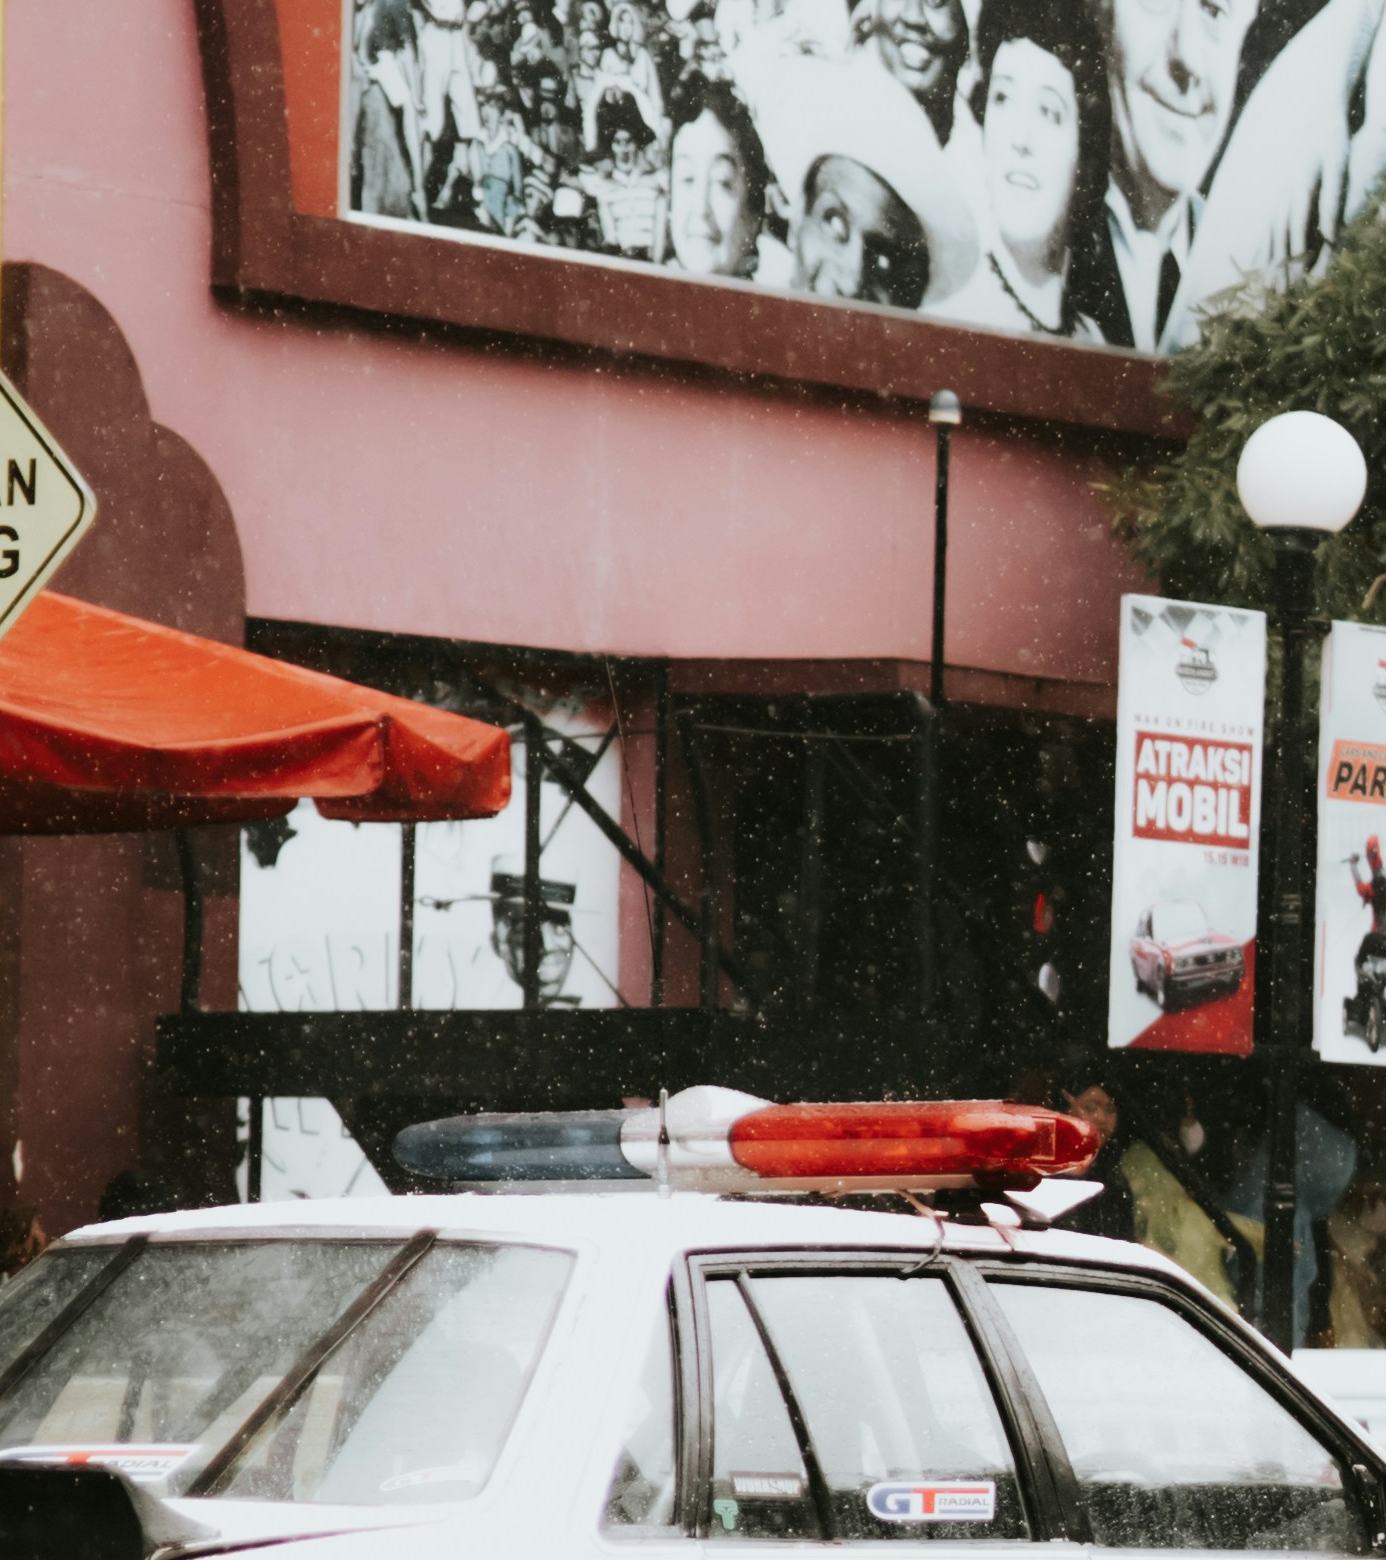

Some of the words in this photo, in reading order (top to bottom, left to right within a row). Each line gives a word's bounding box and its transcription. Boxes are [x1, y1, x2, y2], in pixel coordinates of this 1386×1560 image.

[1136, 737, 1251, 786] ATRAKSI
[1136, 778, 1250, 838] MOBIL
[871, 1487, 943, 1514] GT
[938, 1498, 990, 1507] RADIAL
